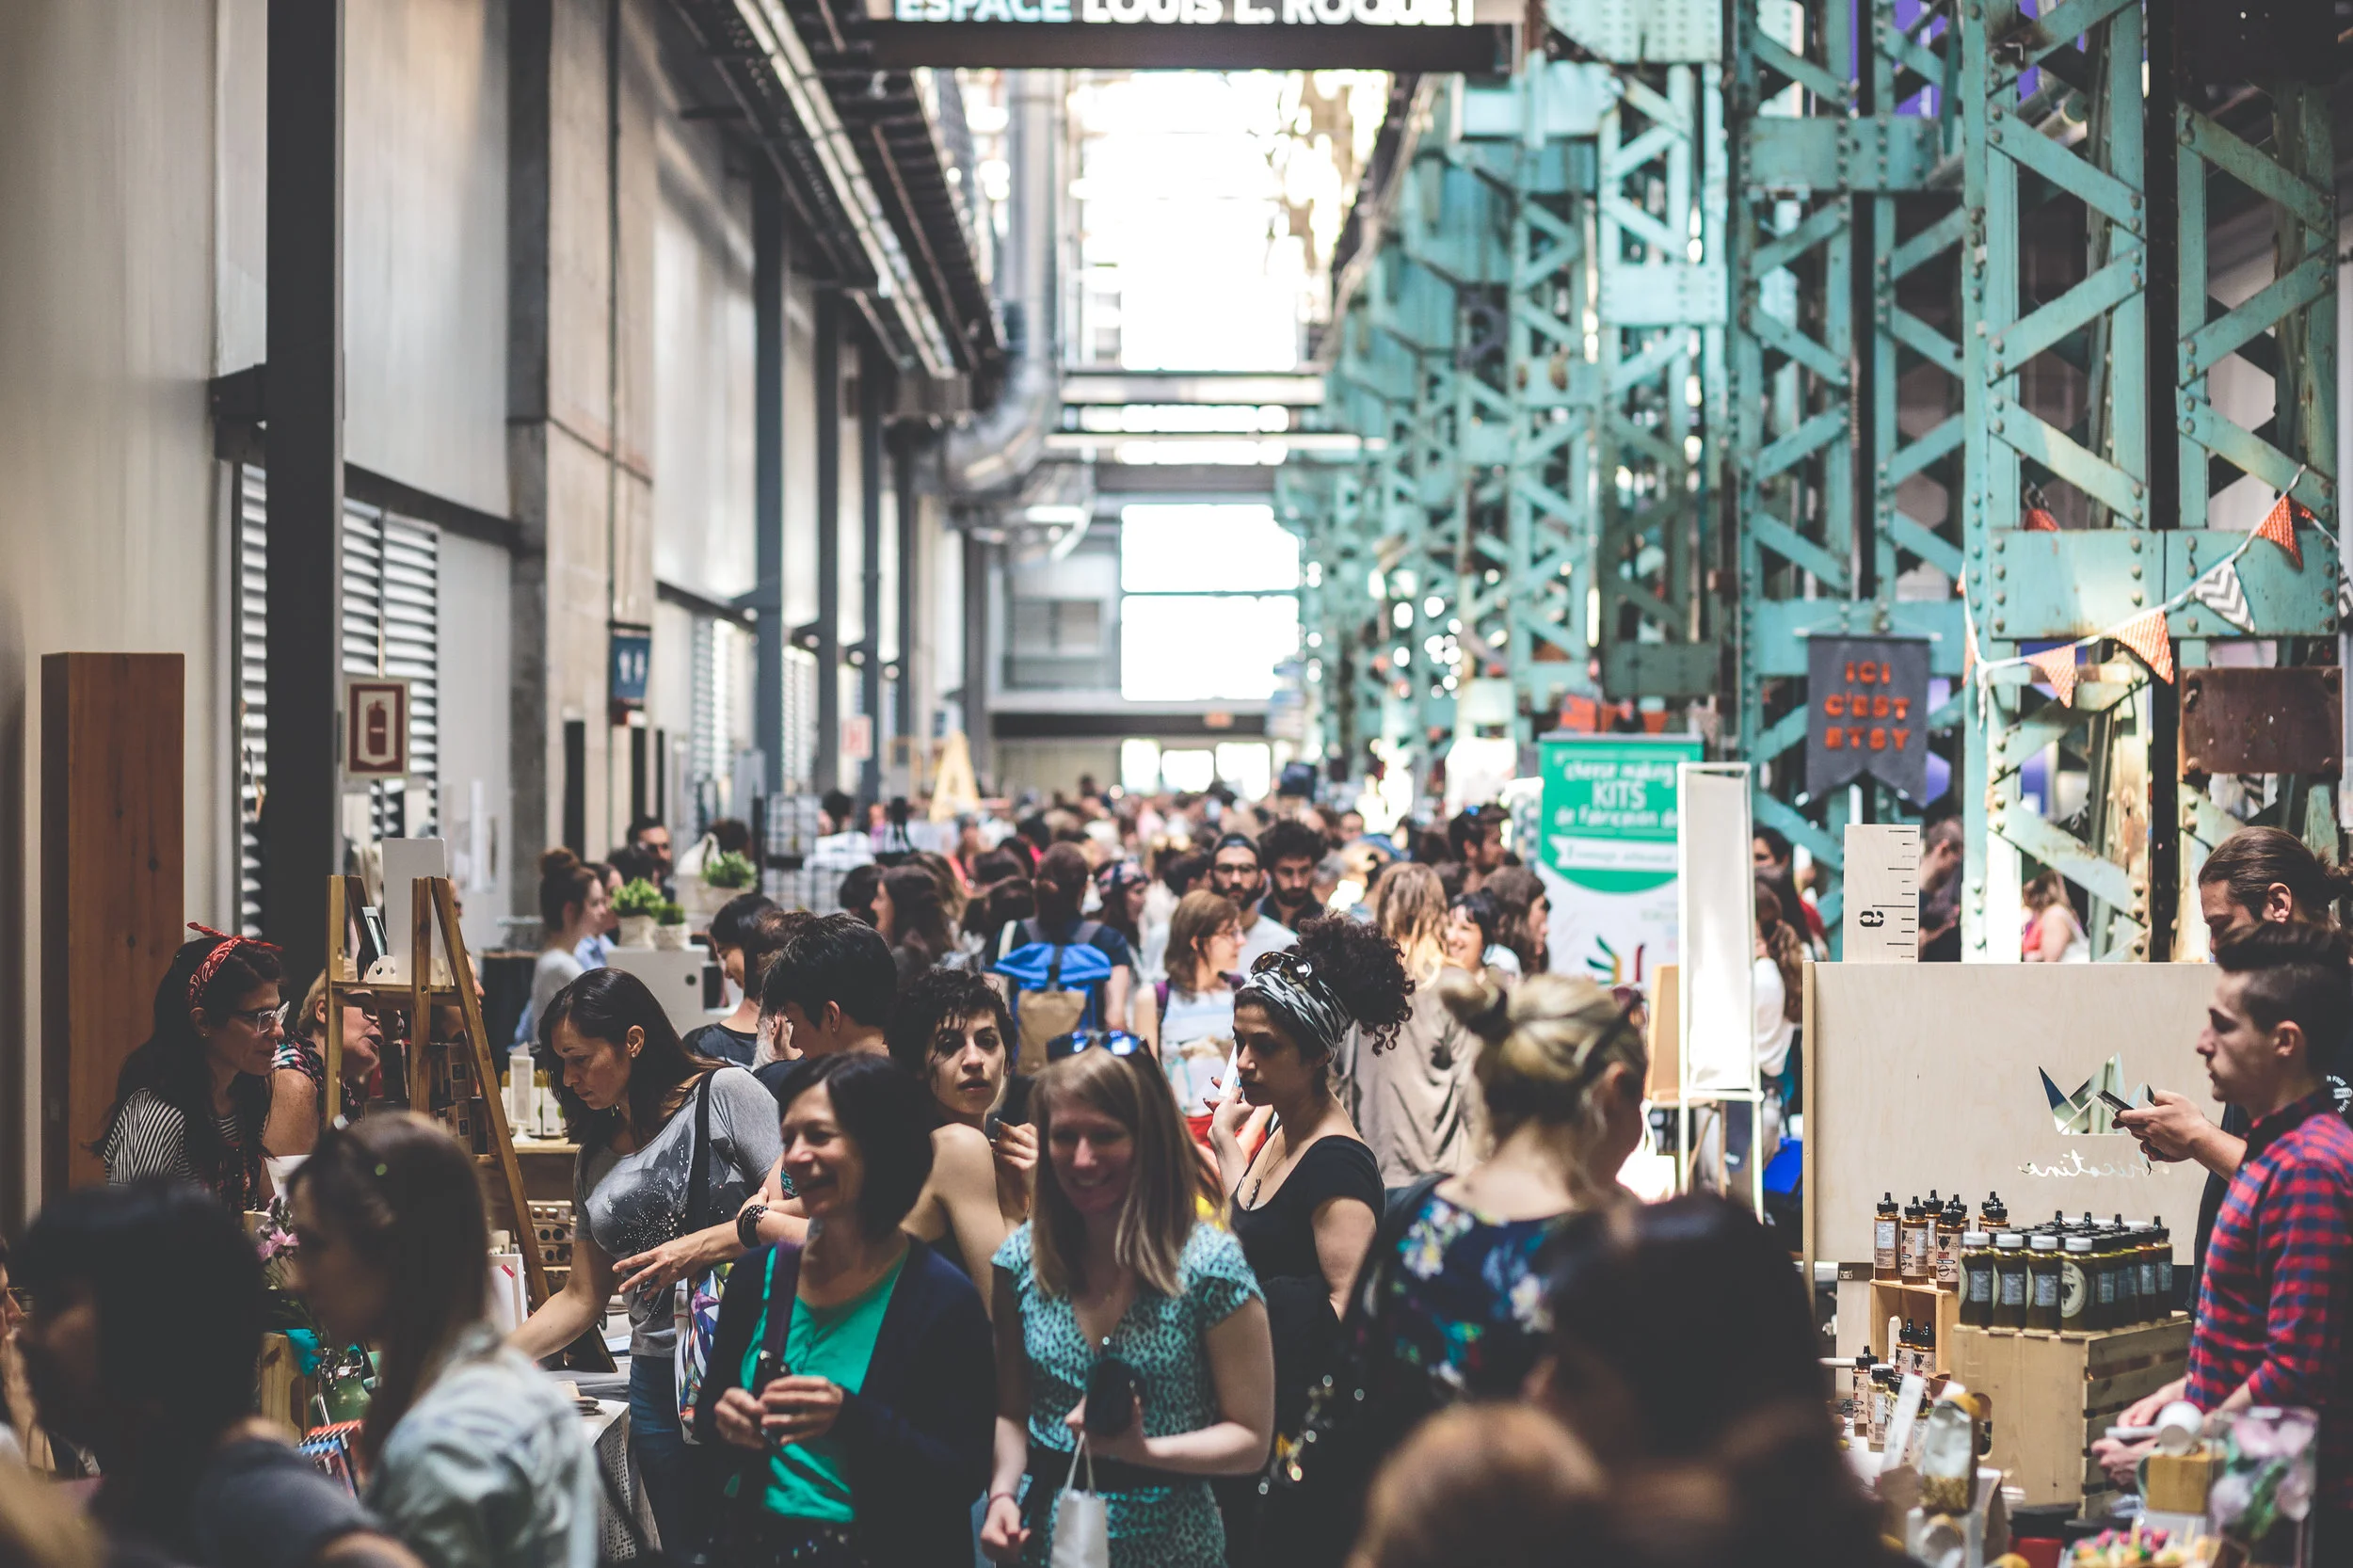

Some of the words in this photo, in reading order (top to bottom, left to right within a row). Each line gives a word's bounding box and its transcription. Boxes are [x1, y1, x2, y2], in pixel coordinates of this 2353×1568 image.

[1846, 661, 1891, 684] ICI
[1824, 690, 1911, 720] C'EST
[1592, 779, 1647, 810] KITS
